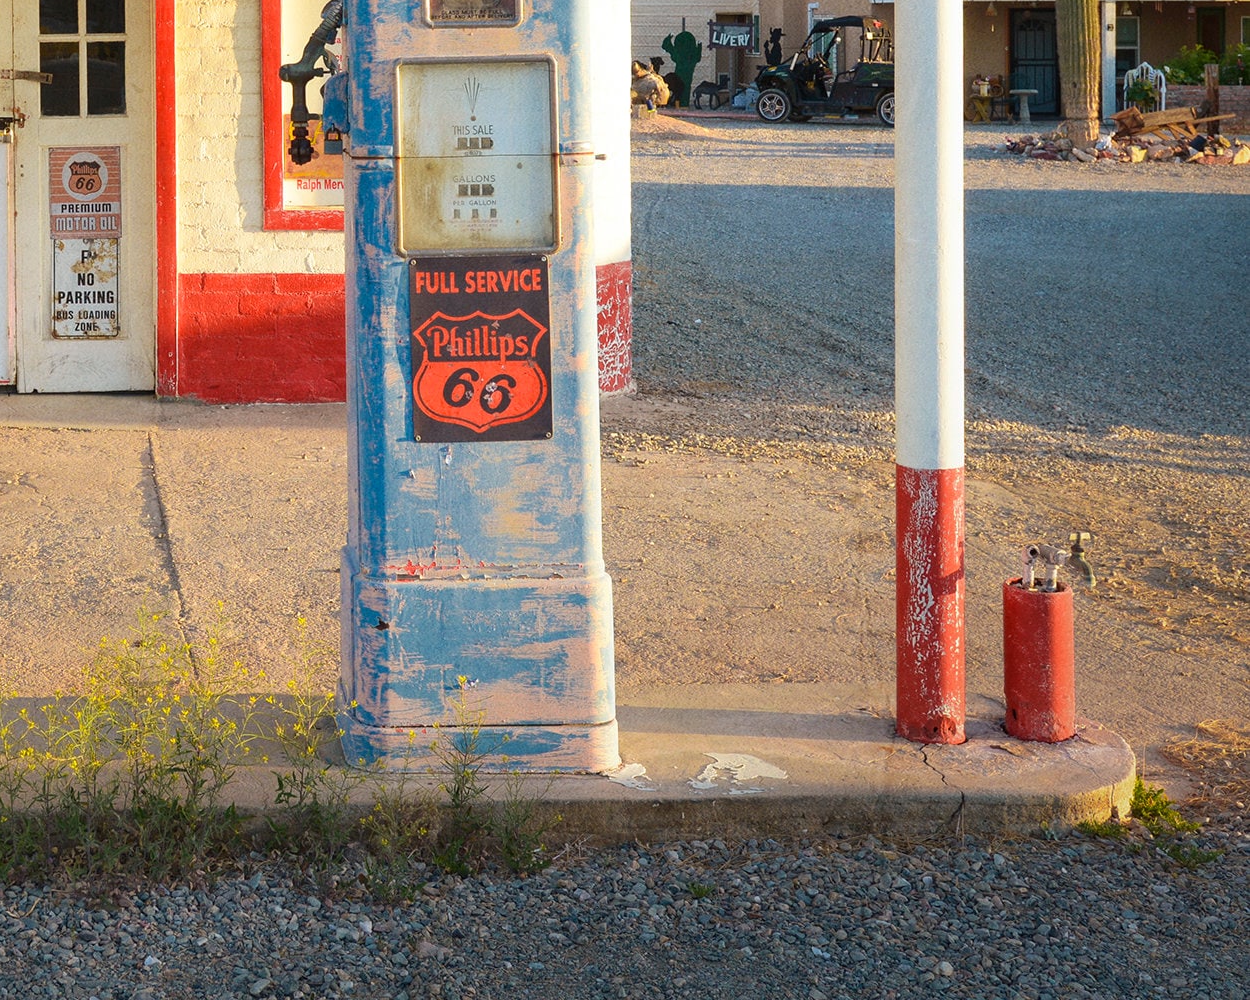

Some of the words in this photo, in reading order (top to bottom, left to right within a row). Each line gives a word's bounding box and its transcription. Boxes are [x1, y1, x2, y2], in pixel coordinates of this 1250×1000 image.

[712, 31, 750, 47] LIVERY
[452, 125, 471, 136] THIS
[472, 125, 494, 135] SALE
[75, 177, 95, 191] 66
[296, 179, 322, 192] Ralph
[452, 175, 496, 183] GALLONS
[61, 202, 112, 214] PREMIUM
[55, 216, 97, 231] MOTOR
[100, 217, 118, 230] OIL
[77, 272, 95, 286] NO
[415, 271, 460, 294] FULL
[464, 268, 542, 293] SERVICE
[57, 290, 115, 305] PARKING
[56, 310, 74, 320] BUS
[78, 310, 116, 320] LOADING
[74, 322, 98, 332] ZONE
[426, 325, 528, 364] Phillips
[442, 367, 517, 415] 66
